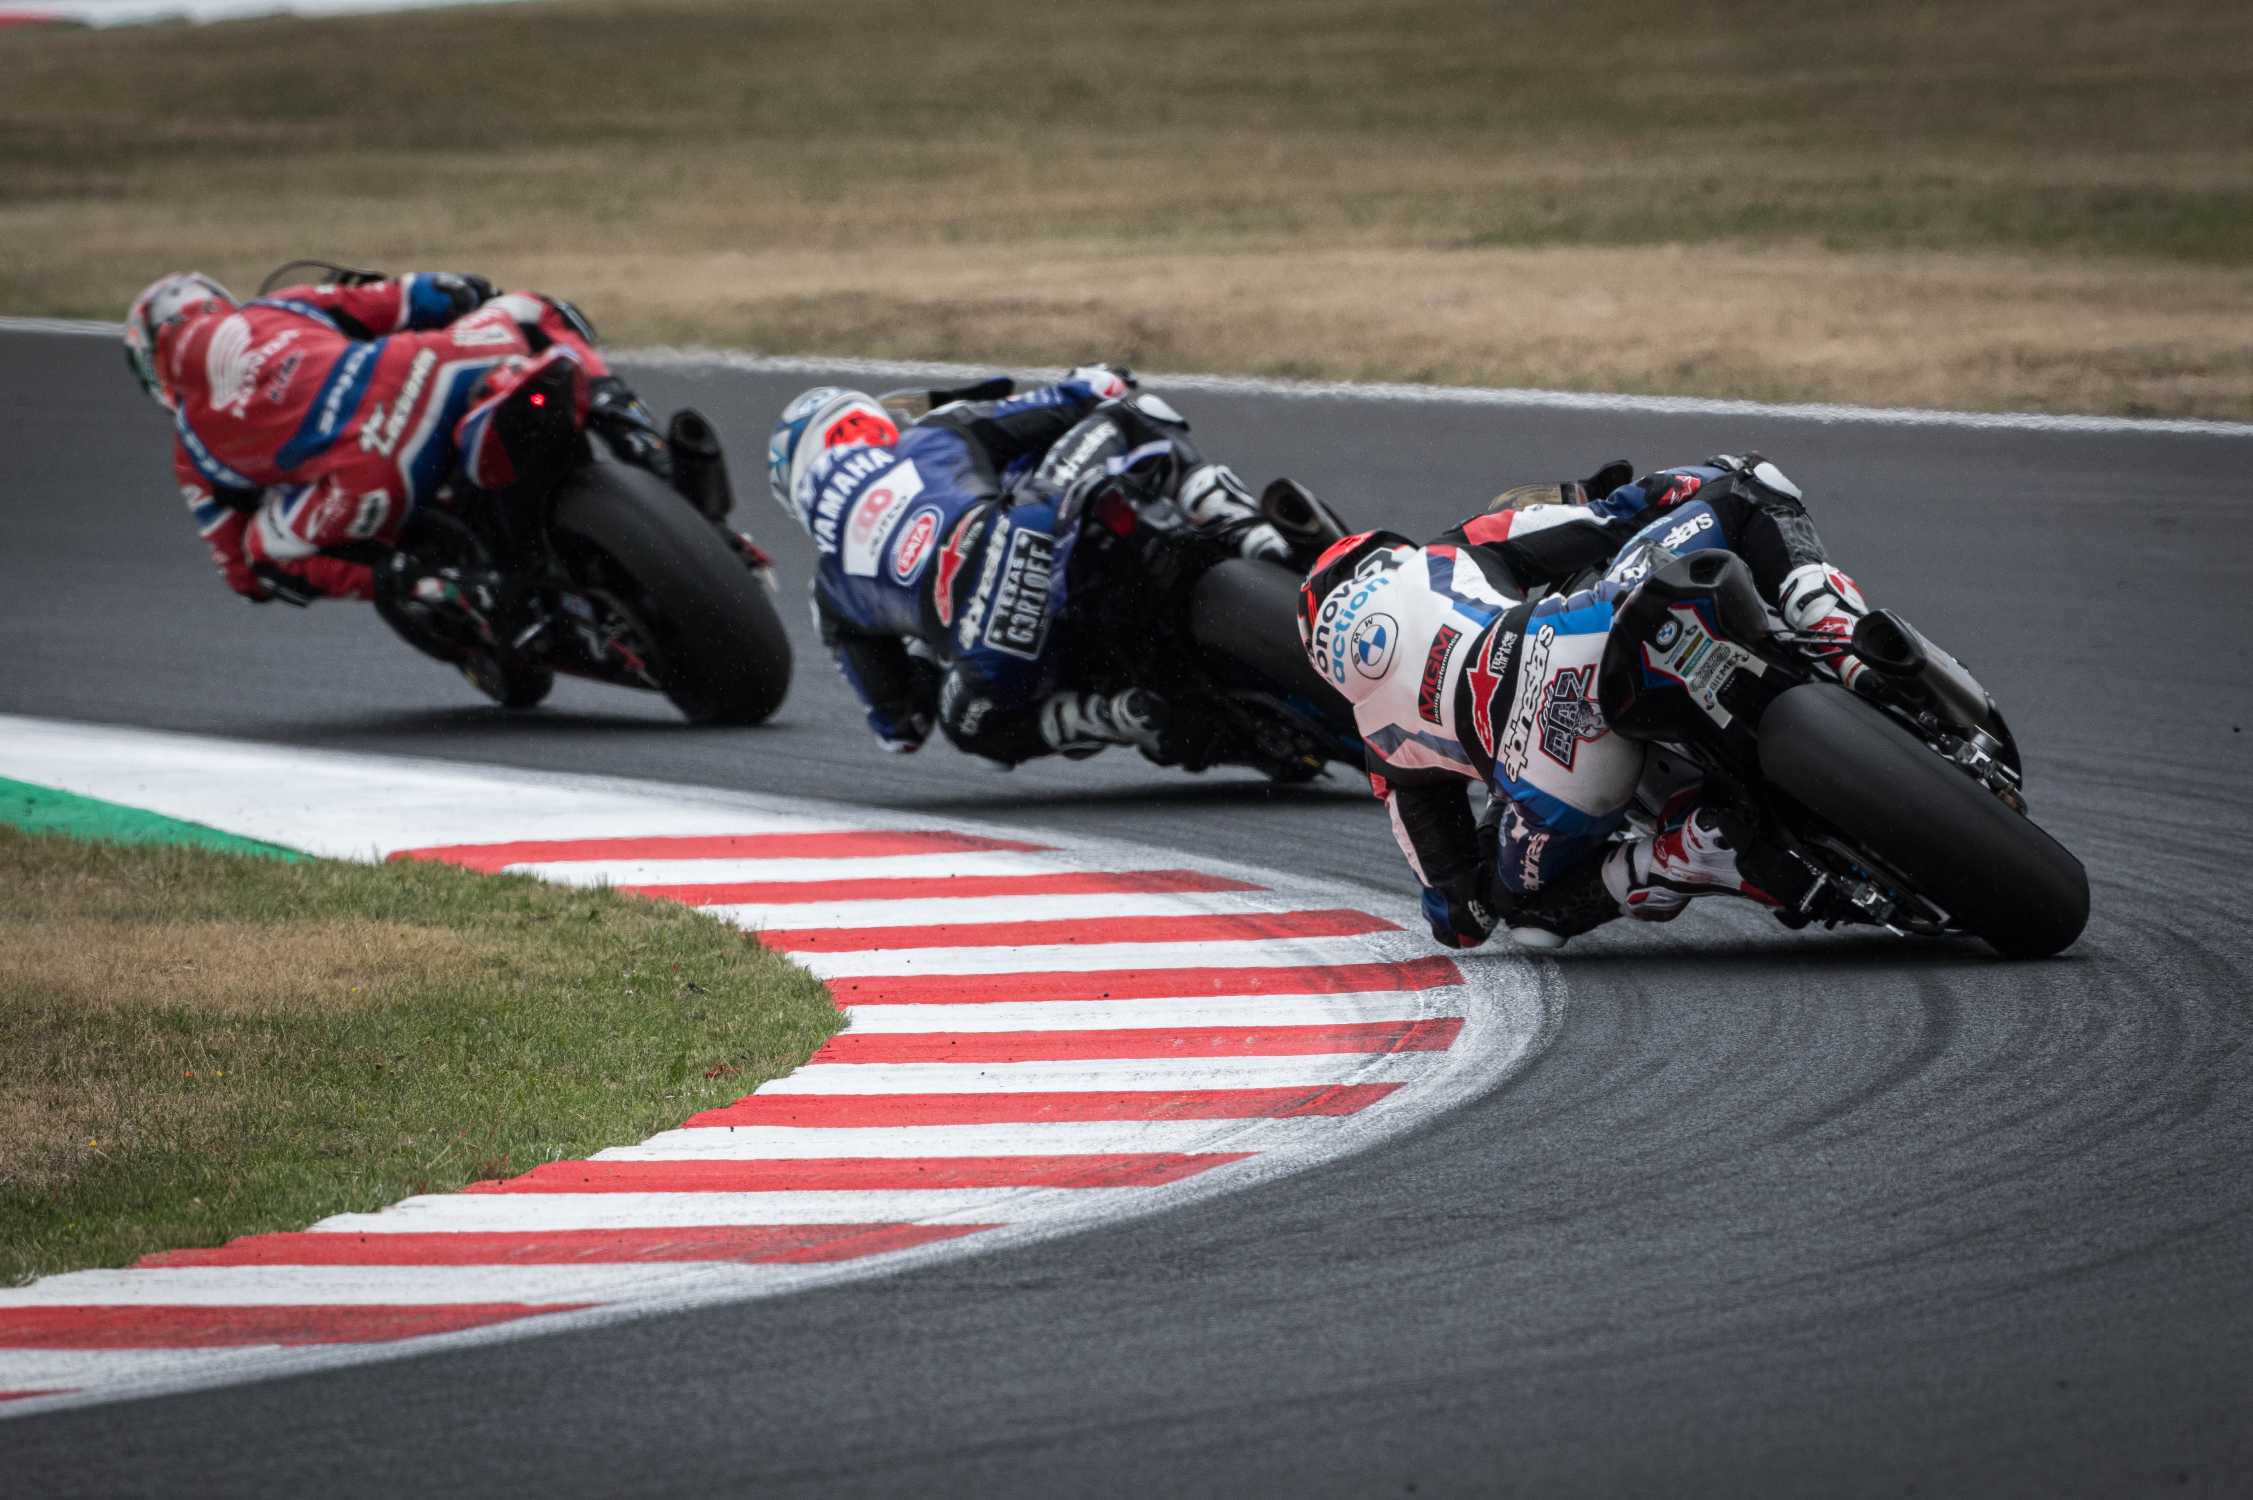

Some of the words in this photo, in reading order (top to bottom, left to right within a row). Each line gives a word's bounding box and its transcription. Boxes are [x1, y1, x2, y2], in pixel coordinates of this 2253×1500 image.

[813, 447, 896, 555] YAMAHA
[998, 557, 1026, 618] TEXAS
[1331, 576, 1391, 684] action
[1419, 626, 1457, 720] MGM
[1437, 632, 1461, 692] performance
[1504, 624, 1556, 783] alpinestars
[1543, 666, 1596, 769] BAZ
[1519, 832, 1550, 892] alpines
